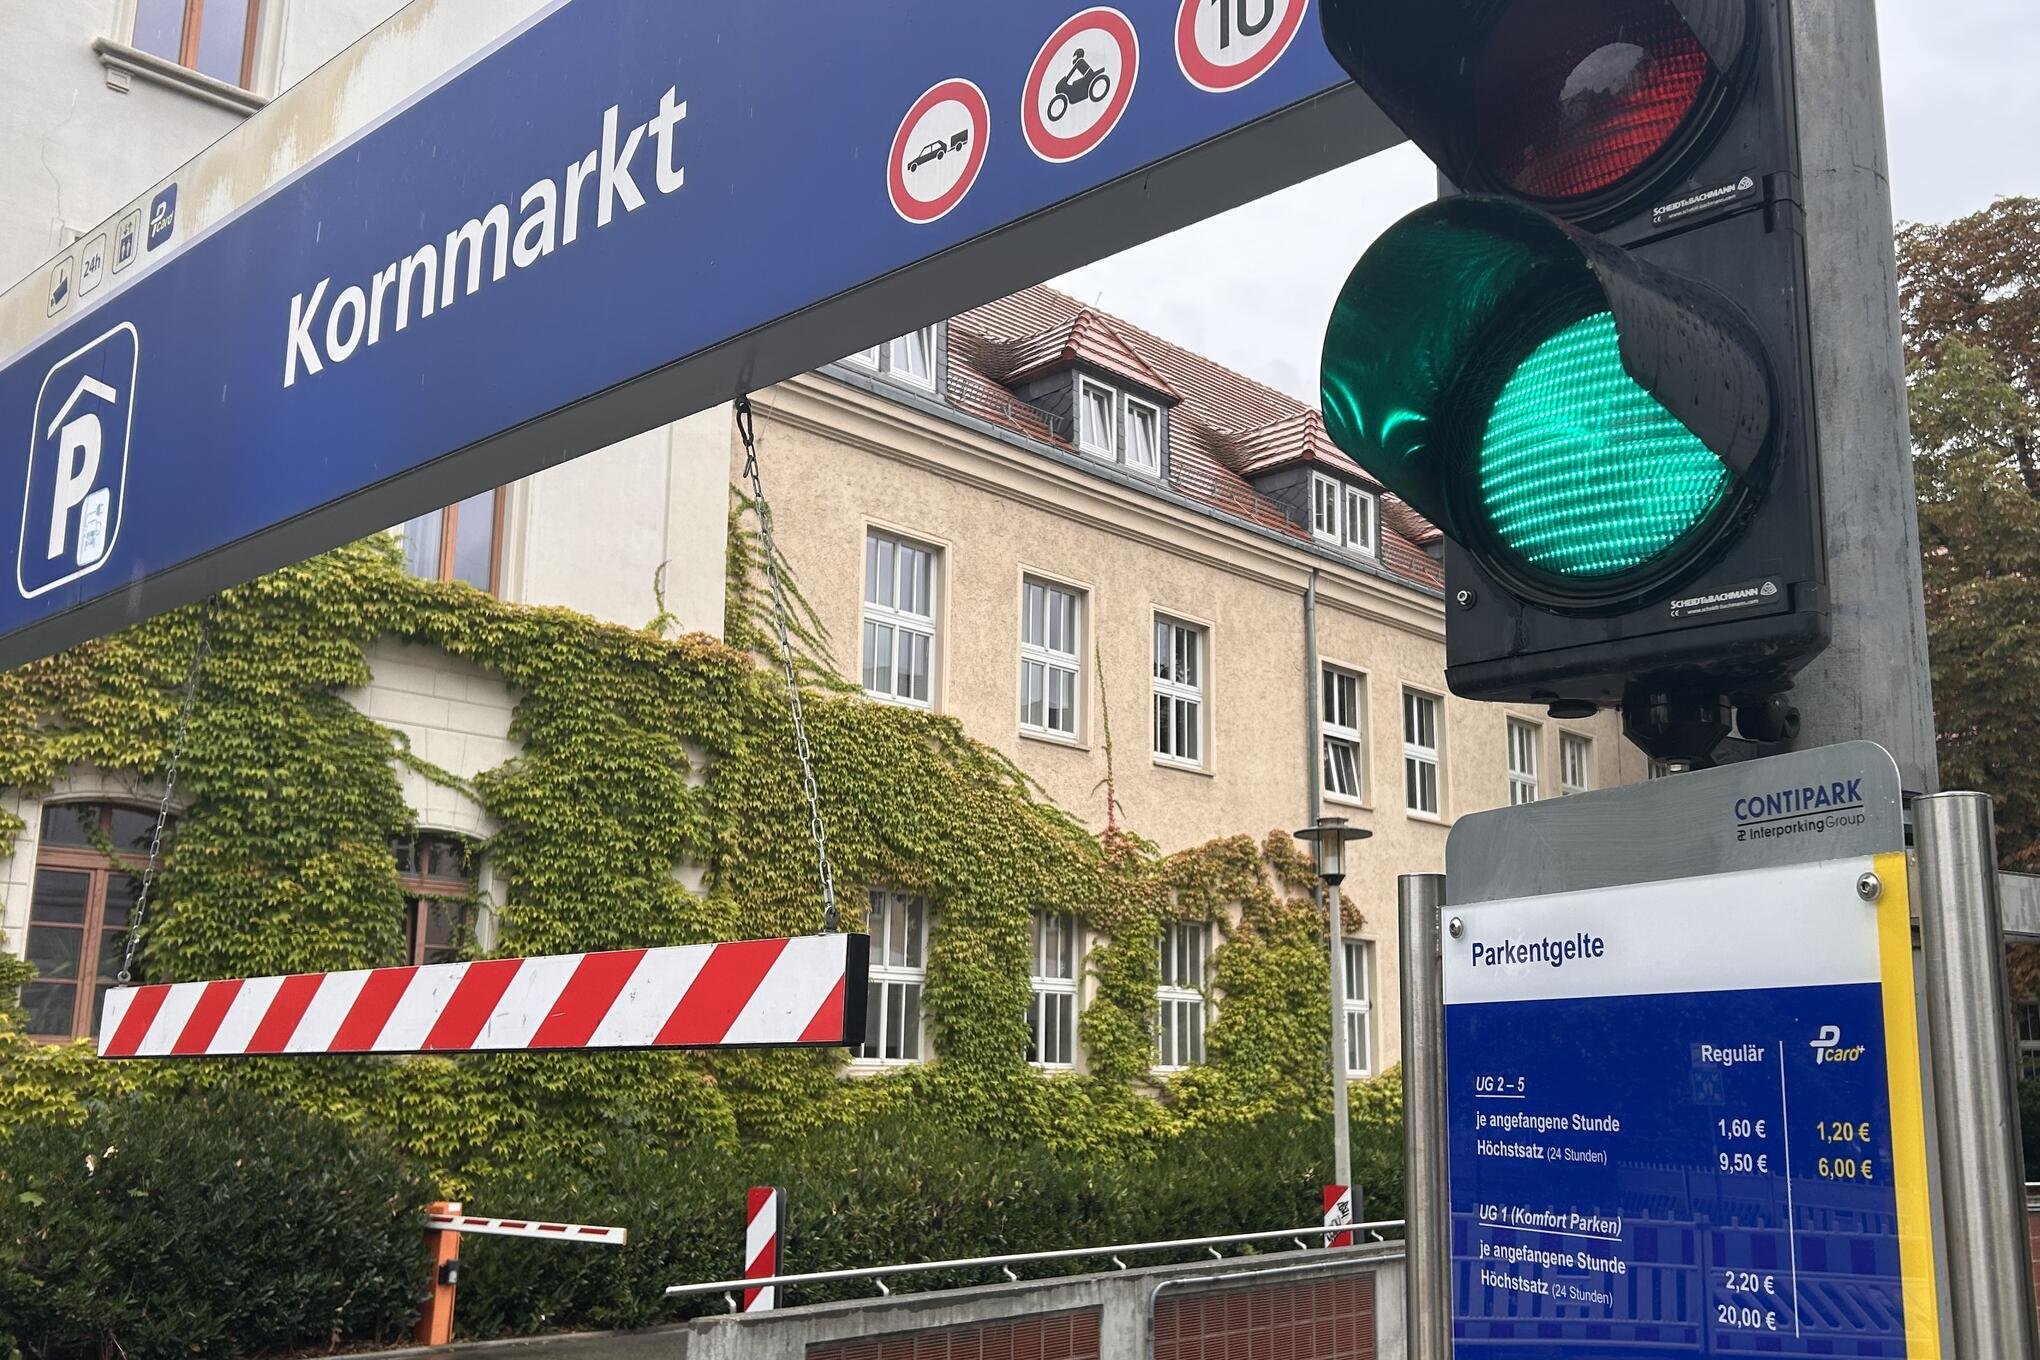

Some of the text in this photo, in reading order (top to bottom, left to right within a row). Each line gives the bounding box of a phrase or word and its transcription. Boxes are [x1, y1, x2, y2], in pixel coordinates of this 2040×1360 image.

[283, 85, 687, 389] Kornmarkt
[83, 253, 101, 278] 24h
[47, 413, 102, 560] P
[1735, 778, 1862, 820] CONTIPARK
[1472, 932, 1604, 967] Parkentgelte
[1701, 1044, 1765, 1066] Regulär
[1476, 1076, 1494, 1091] UG
[1497, 1076, 1504, 1091] 2
[1517, 1077, 1525, 1091] 5
[1475, 1111, 1620, 1133] je angefangene Stunde
[1717, 1118, 1766, 1140] 1,60 €
[1816, 1121, 1871, 1144] 1,20 €
[1477, 1139, 1608, 1166] Höchstsatz (24 Stunden)
[1719, 1152, 1768, 1175] 9,50 €
[1818, 1157, 1873, 1181] 6,00 €
[1479, 1204, 1622, 1237] UG 1 (Komfort Parken)
[1479, 1240, 1627, 1274] je angefangene Stunde
[1481, 1269, 1613, 1308] Höchstsatz (24 Stunden)
[1725, 1270, 1775, 1295] 2,20 €
[1718, 1304, 1777, 1331] 20,00 €
